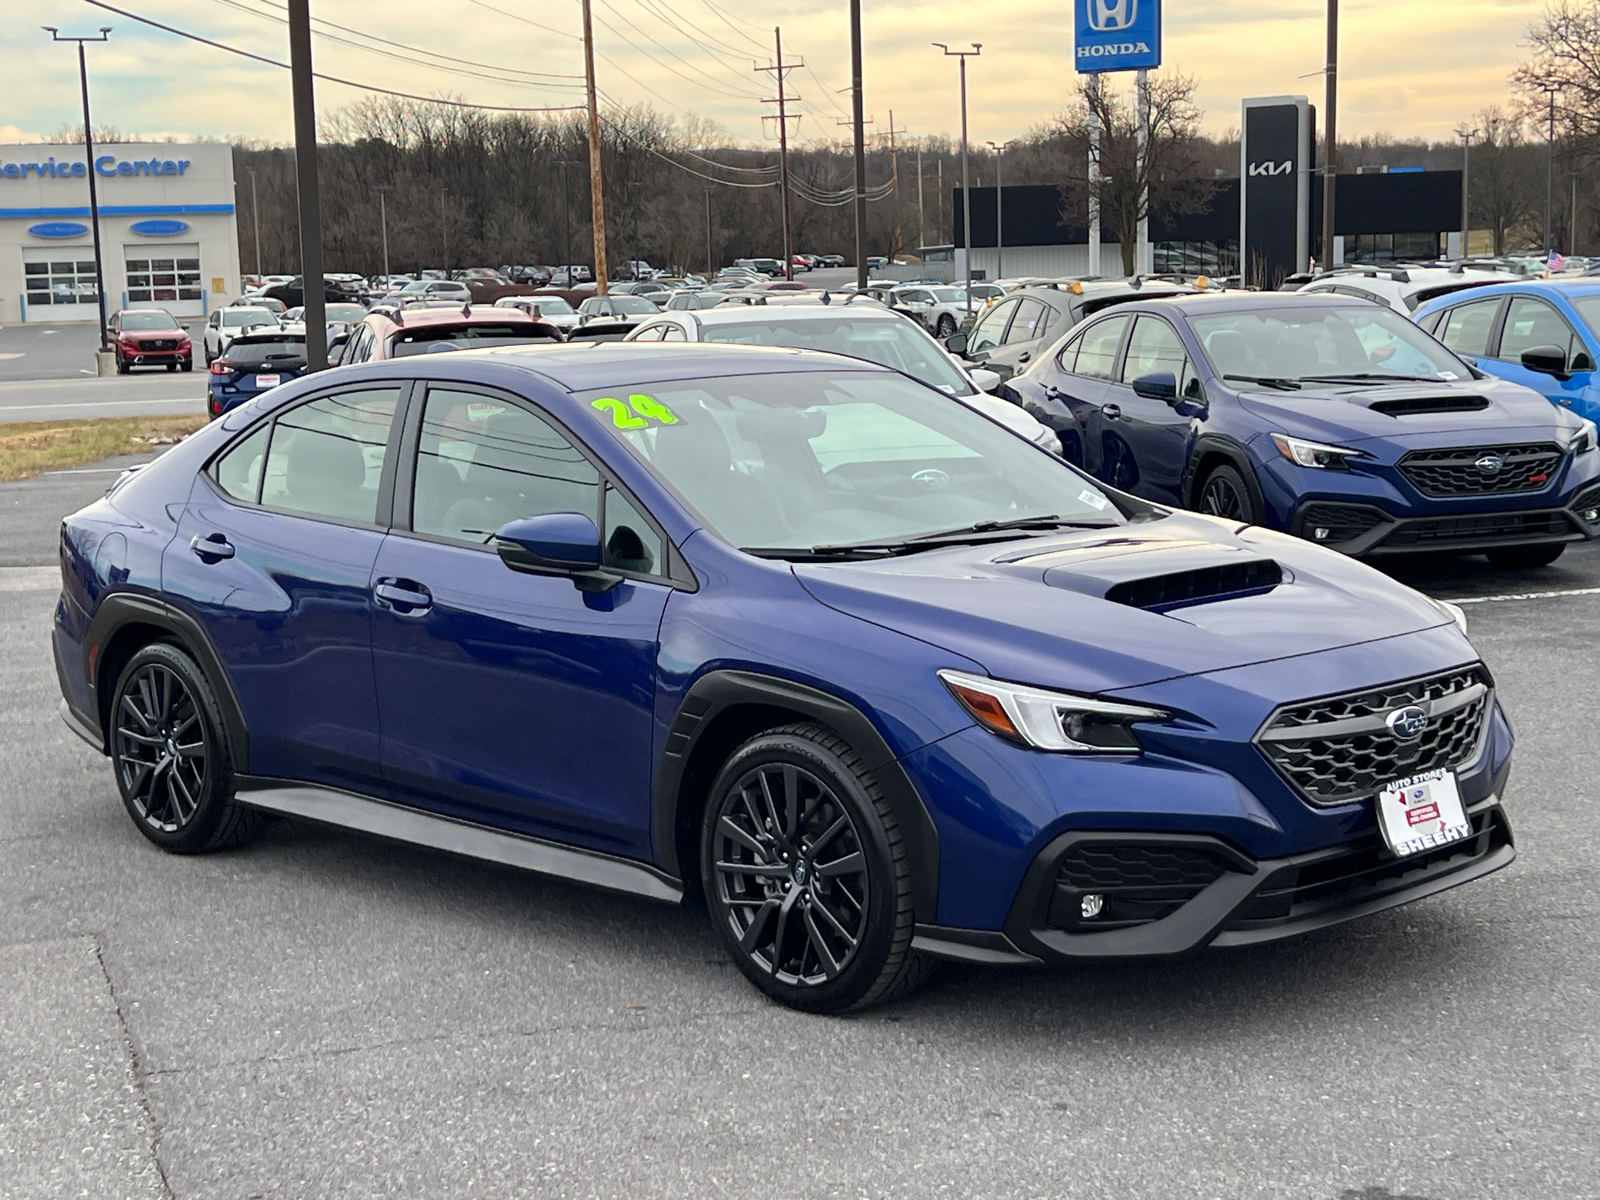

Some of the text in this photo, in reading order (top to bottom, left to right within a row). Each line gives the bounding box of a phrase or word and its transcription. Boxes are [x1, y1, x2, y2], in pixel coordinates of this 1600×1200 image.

[1077, 42, 1151, 58] HONDA
[95, 155, 191, 177] Center
[1249, 160, 1293, 177] KIA
[591, 393, 679, 430] 24
[1386, 767, 1448, 793] AUTO STORES
[1396, 824, 1469, 857] SHEEHY
